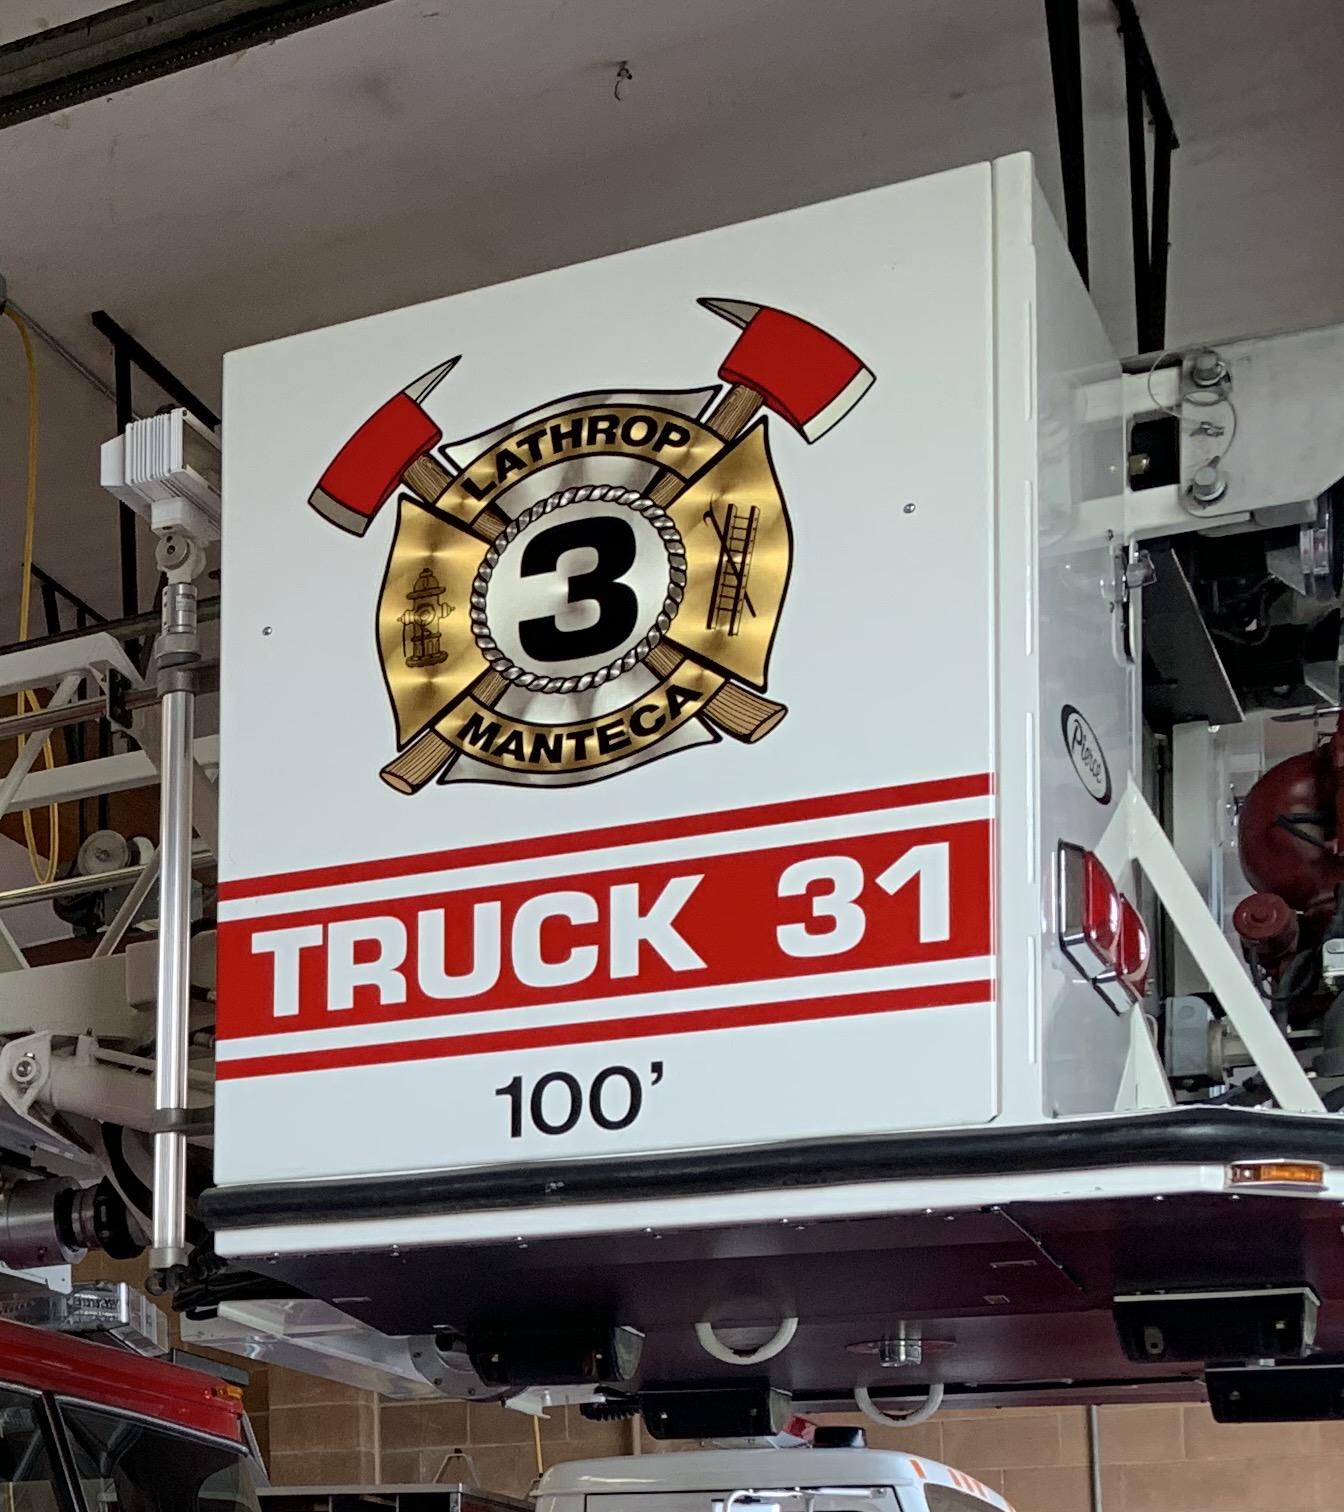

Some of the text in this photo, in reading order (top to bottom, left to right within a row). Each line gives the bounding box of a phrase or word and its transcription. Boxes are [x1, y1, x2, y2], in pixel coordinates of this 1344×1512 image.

[460, 414, 691, 502] LATHROP
[518, 514, 640, 663] 3
[457, 680, 704, 765] MANTECA
[1072, 718, 1102, 784] Pierce
[251, 842, 951, 1018] TRUCK 31
